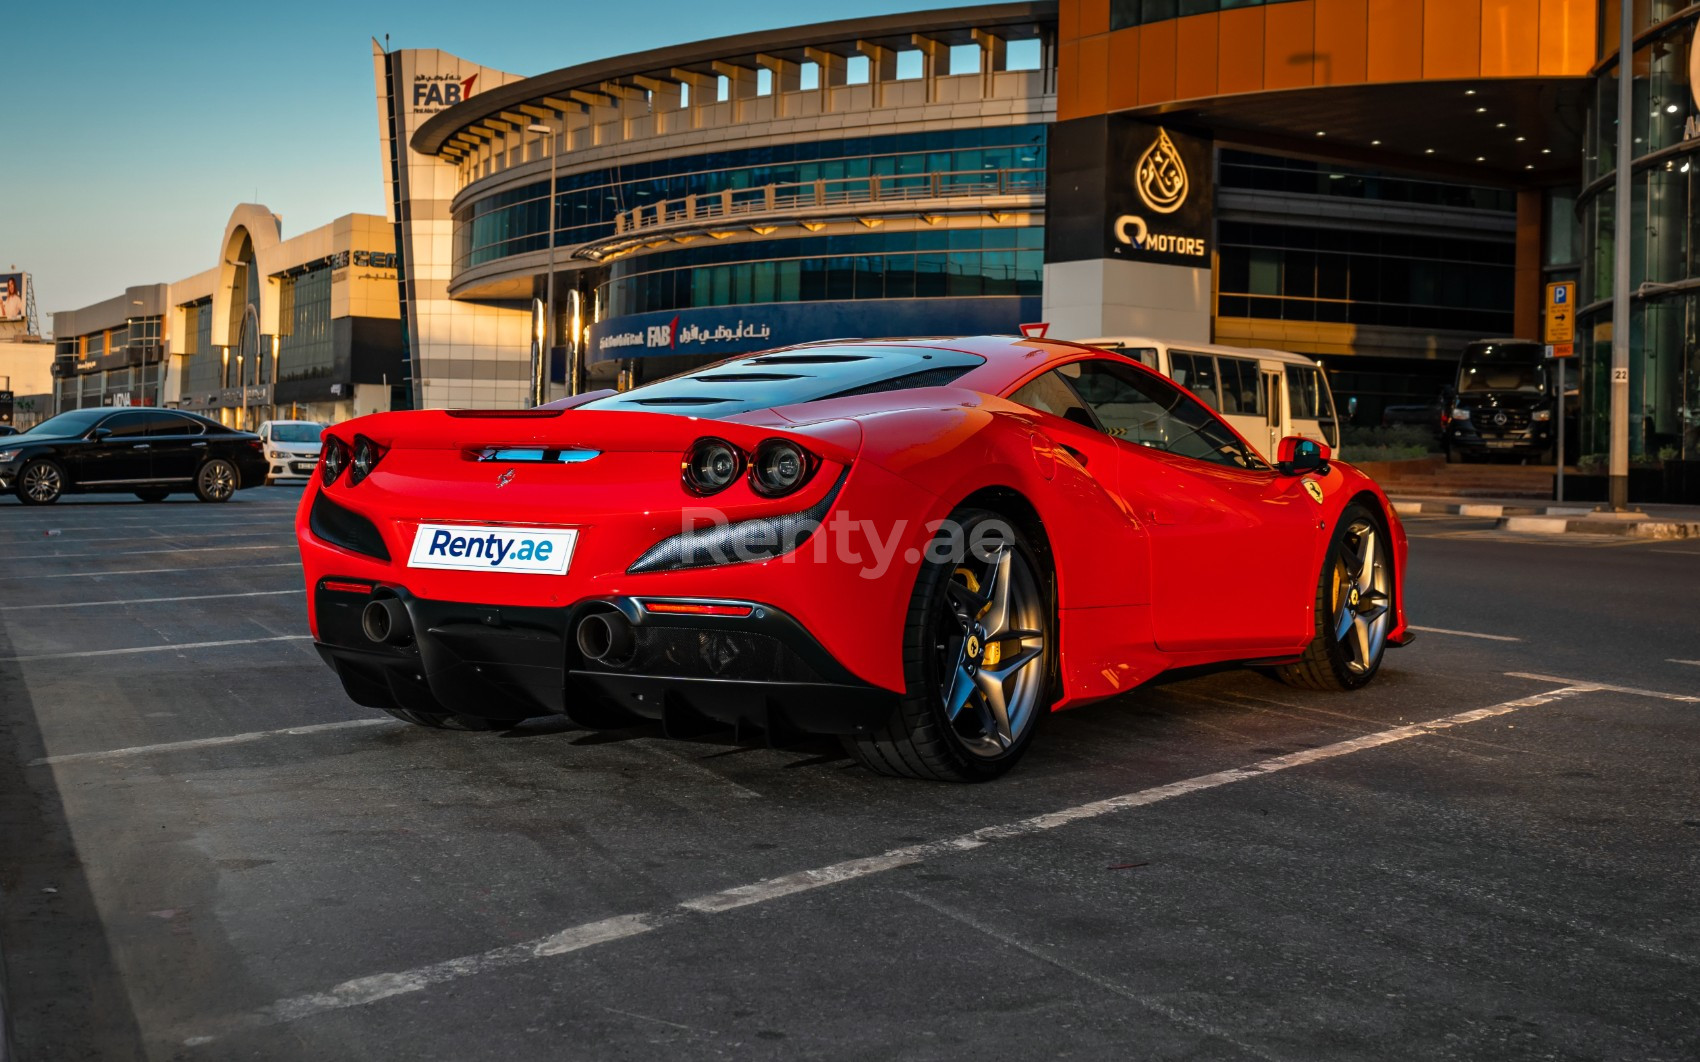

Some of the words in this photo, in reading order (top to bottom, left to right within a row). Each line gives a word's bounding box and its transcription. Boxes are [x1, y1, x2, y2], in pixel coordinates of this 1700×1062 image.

[1145, 234, 1205, 256] MOTORS
[1615, 370, 1627, 380] 22
[429, 530, 553, 566] Renty.ae
